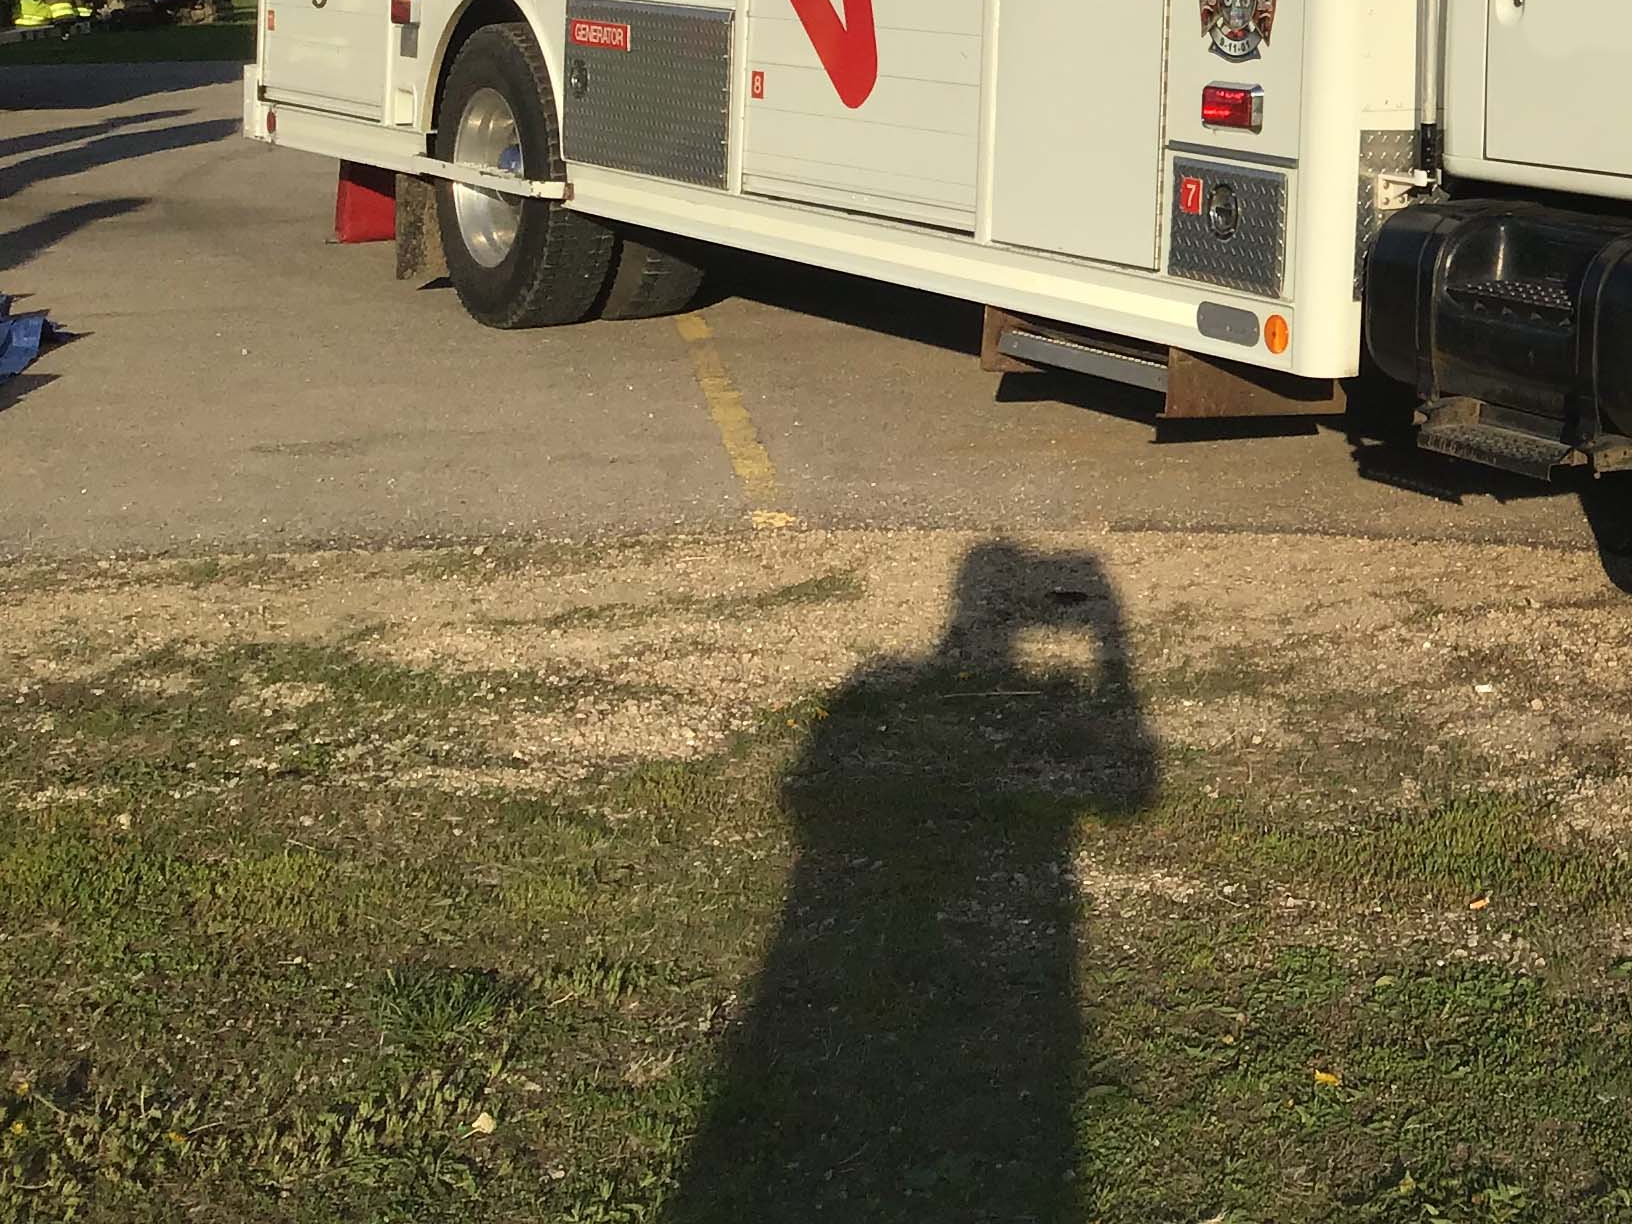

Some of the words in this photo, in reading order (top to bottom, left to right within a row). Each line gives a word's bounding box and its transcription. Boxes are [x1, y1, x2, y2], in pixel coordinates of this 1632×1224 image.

[574, 23, 624, 47] GENERATOR
[1219, 36, 1250, 54] 9-11-01
[753, 76, 762, 94] 8
[1186, 184, 1197, 207] 7
